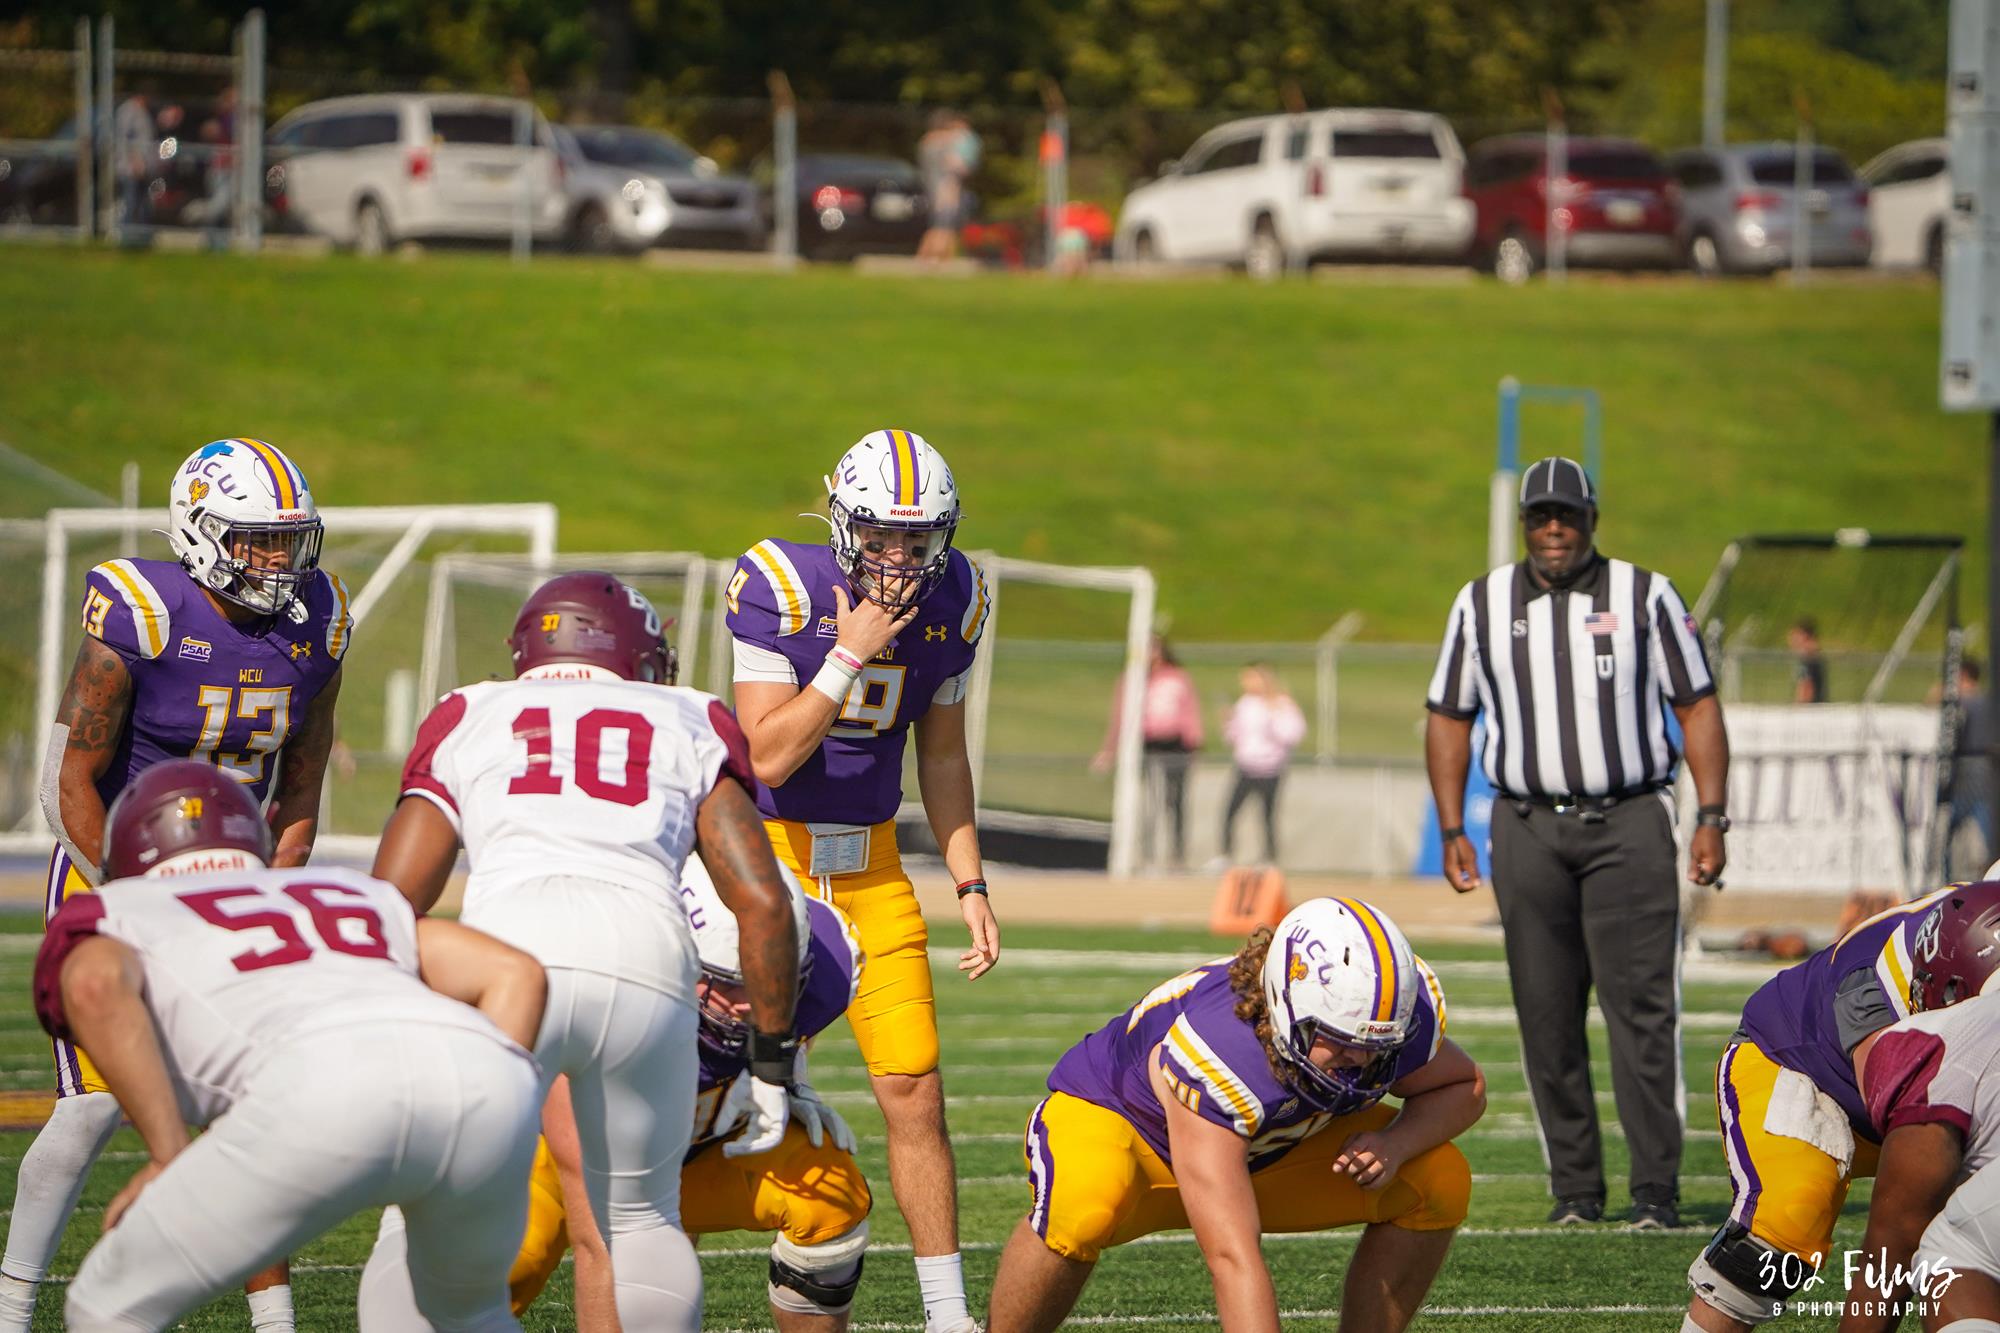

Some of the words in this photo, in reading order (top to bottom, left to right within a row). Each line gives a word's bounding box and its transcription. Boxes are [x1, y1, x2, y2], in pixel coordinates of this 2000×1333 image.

[186, 459, 237, 494] WCU
[841, 453, 857, 485] CU
[890, 509, 923, 517] Riddell
[725, 567, 750, 615] 9
[81, 585, 113, 640] 13
[818, 623, 838, 633] PSA
[1512, 619, 1528, 638] S
[180, 643, 212, 657] PSAC
[1596, 654, 1614, 679] U
[239, 669, 263, 683] WCU
[828, 663, 907, 738] 9
[190, 685, 292, 784] 13
[507, 708, 654, 807] 10
[175, 882, 396, 972] 56
[680, 887, 706, 930] CU
[1290, 926, 1334, 985] WCU
